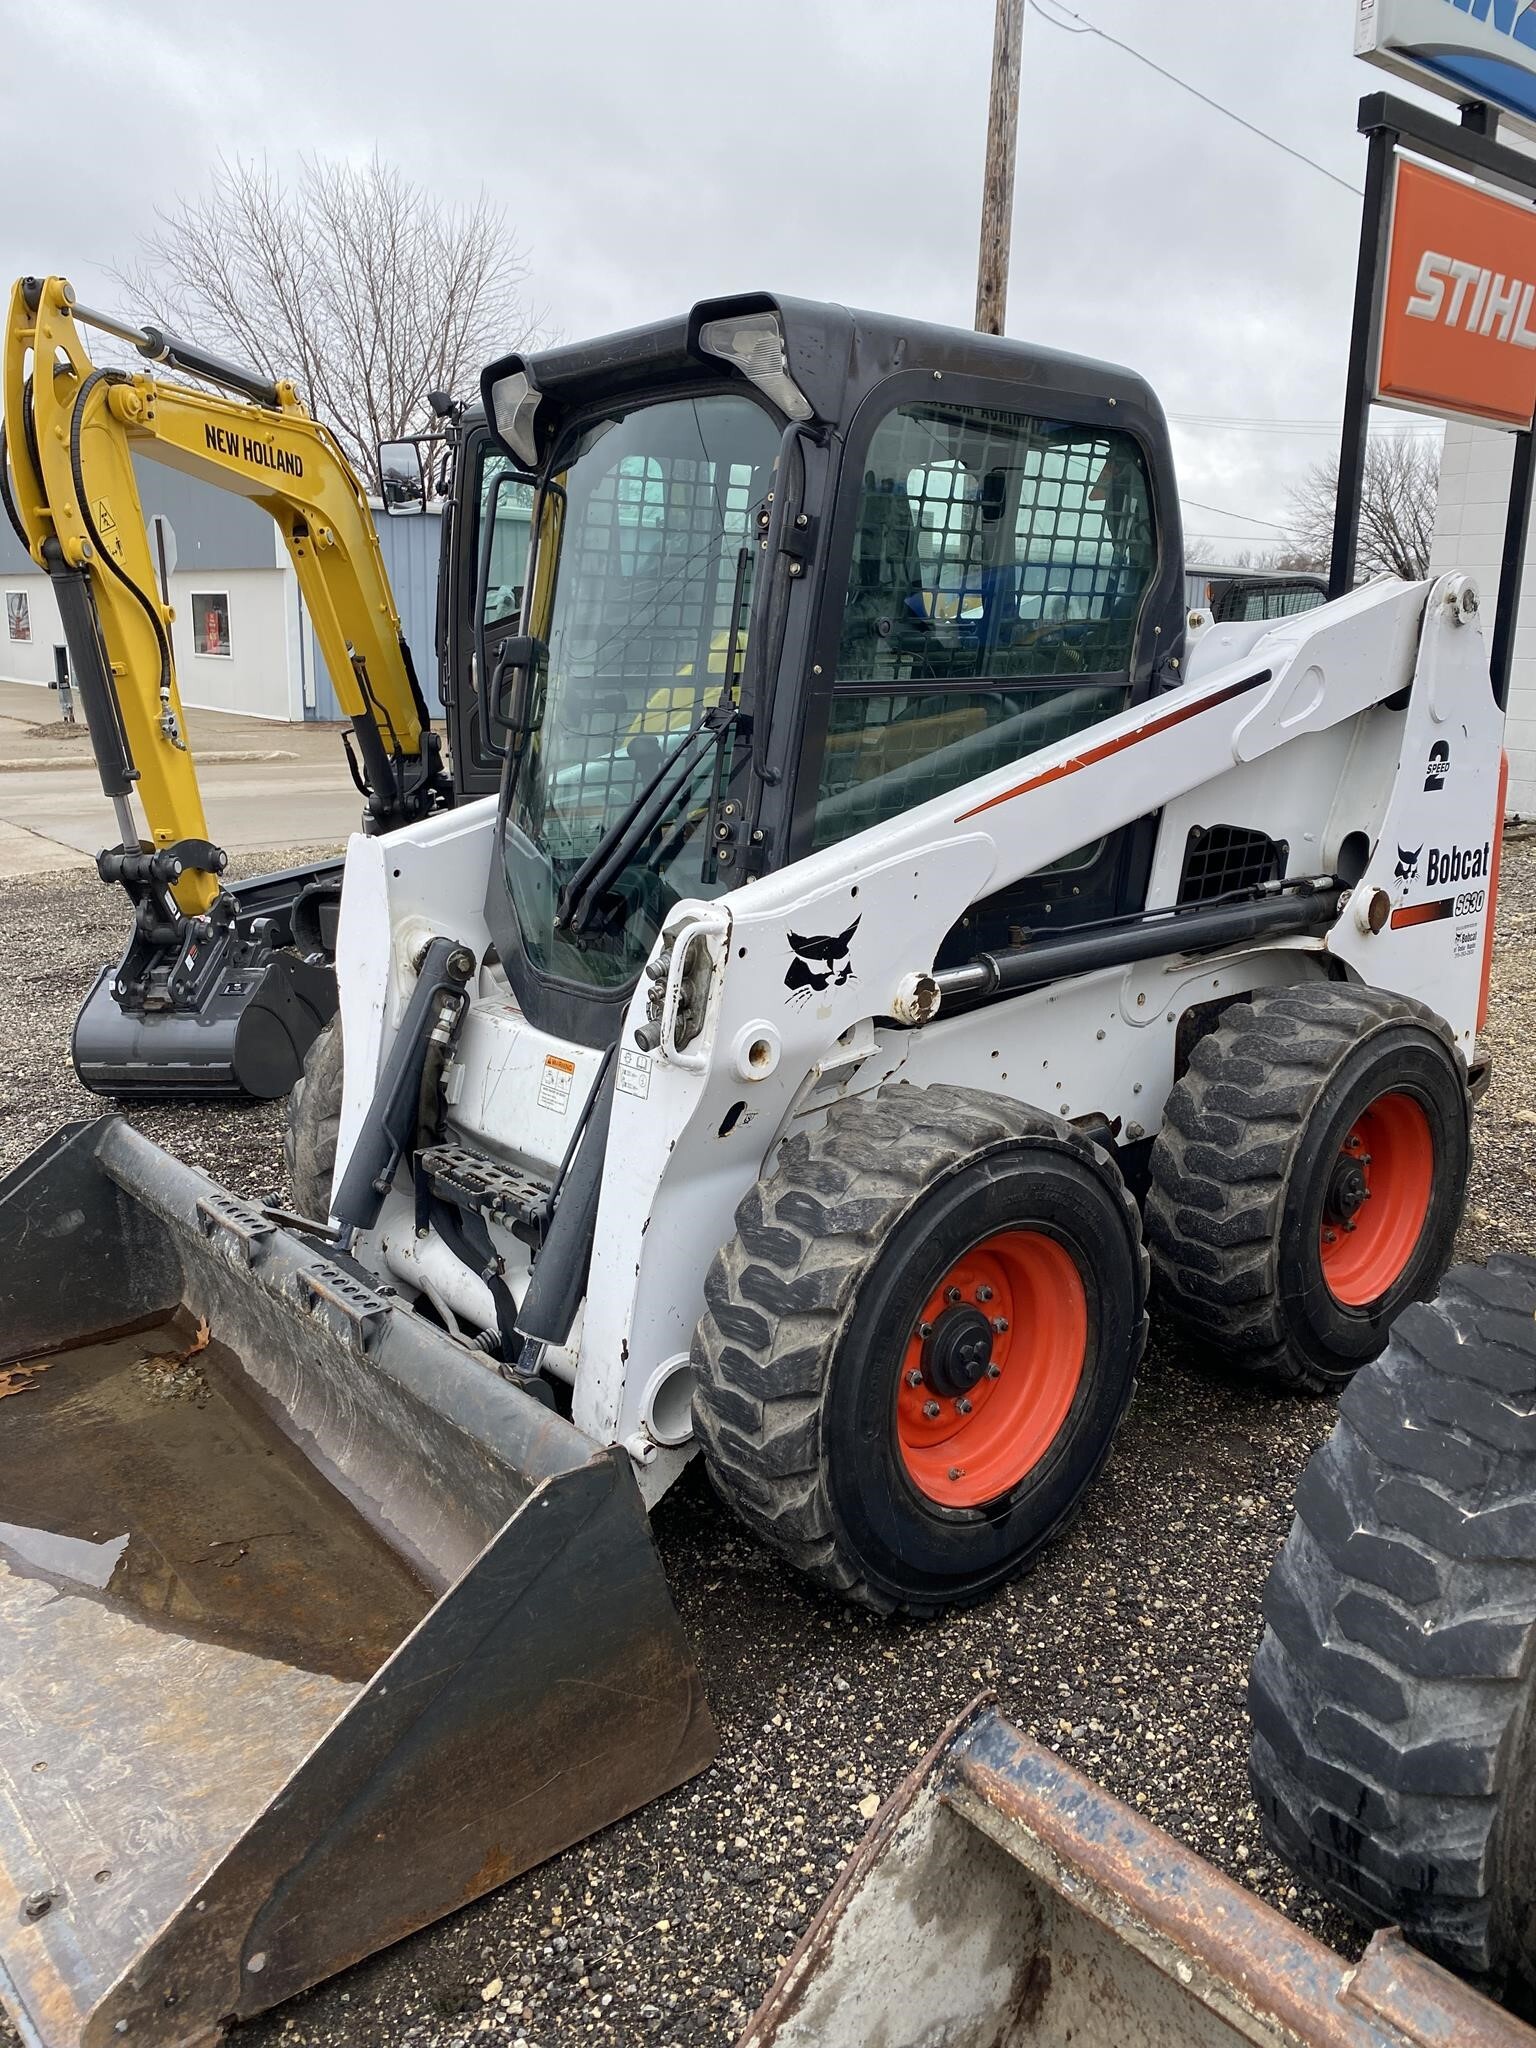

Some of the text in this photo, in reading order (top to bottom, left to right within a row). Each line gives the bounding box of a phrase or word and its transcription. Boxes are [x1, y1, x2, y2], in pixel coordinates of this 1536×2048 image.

[1406, 250, 1536, 350] STIHL
[205, 423, 303, 478] NEW HOLLAND
[1423, 739, 1450, 792] 2
[1426, 761, 1450, 775] SPEED
[1426, 842, 1490, 886] Bobcat
[1454, 889, 1485, 917] S630
